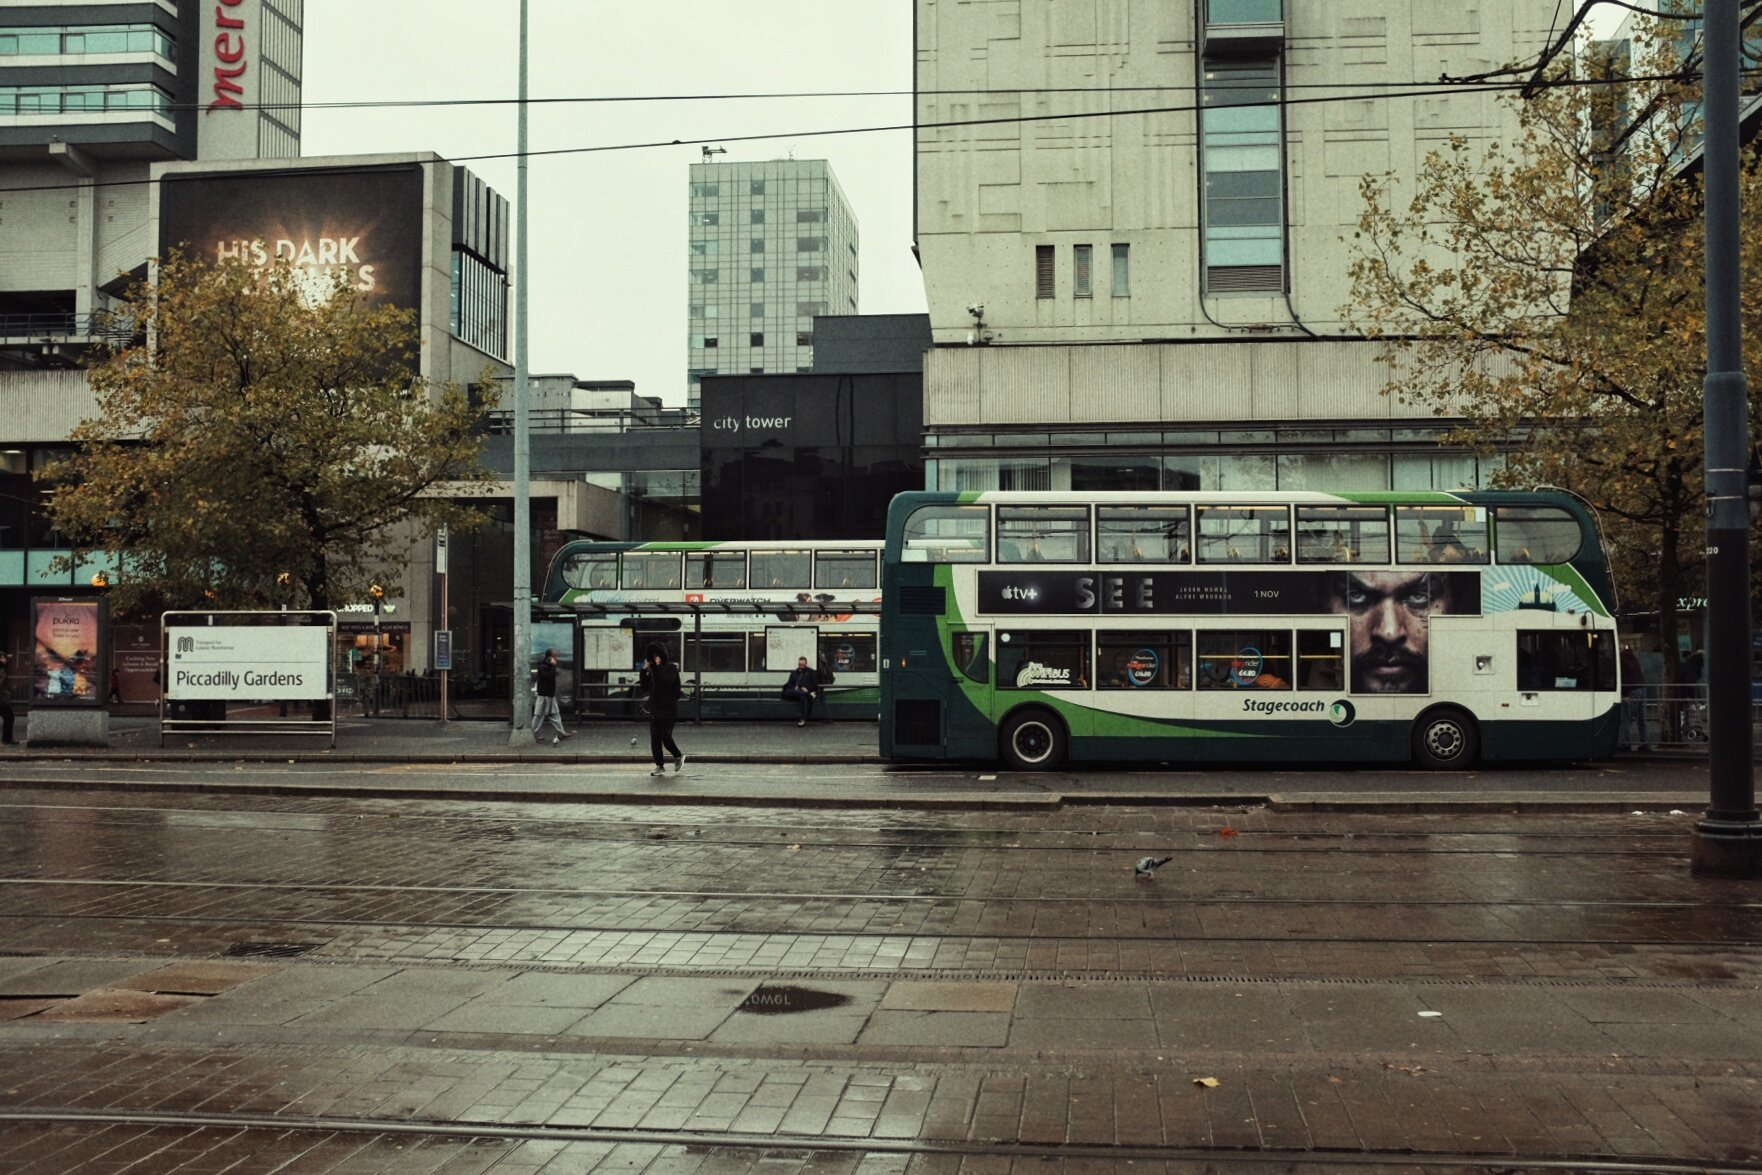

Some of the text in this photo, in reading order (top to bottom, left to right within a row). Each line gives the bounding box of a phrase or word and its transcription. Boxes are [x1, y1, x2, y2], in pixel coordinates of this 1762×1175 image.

[206, 0, 247, 115] mer
[218, 237, 361, 266] HIS DARK
[713, 415, 792, 432] city tower
[1013, 586, 1038, 600] tv+
[1076, 577, 1154, 609] SEE
[1254, 590, 1280, 598] 1 NOV
[176, 670, 304, 690] Piccadilly Gardens
[1242, 698, 1325, 715] Stagecoach
